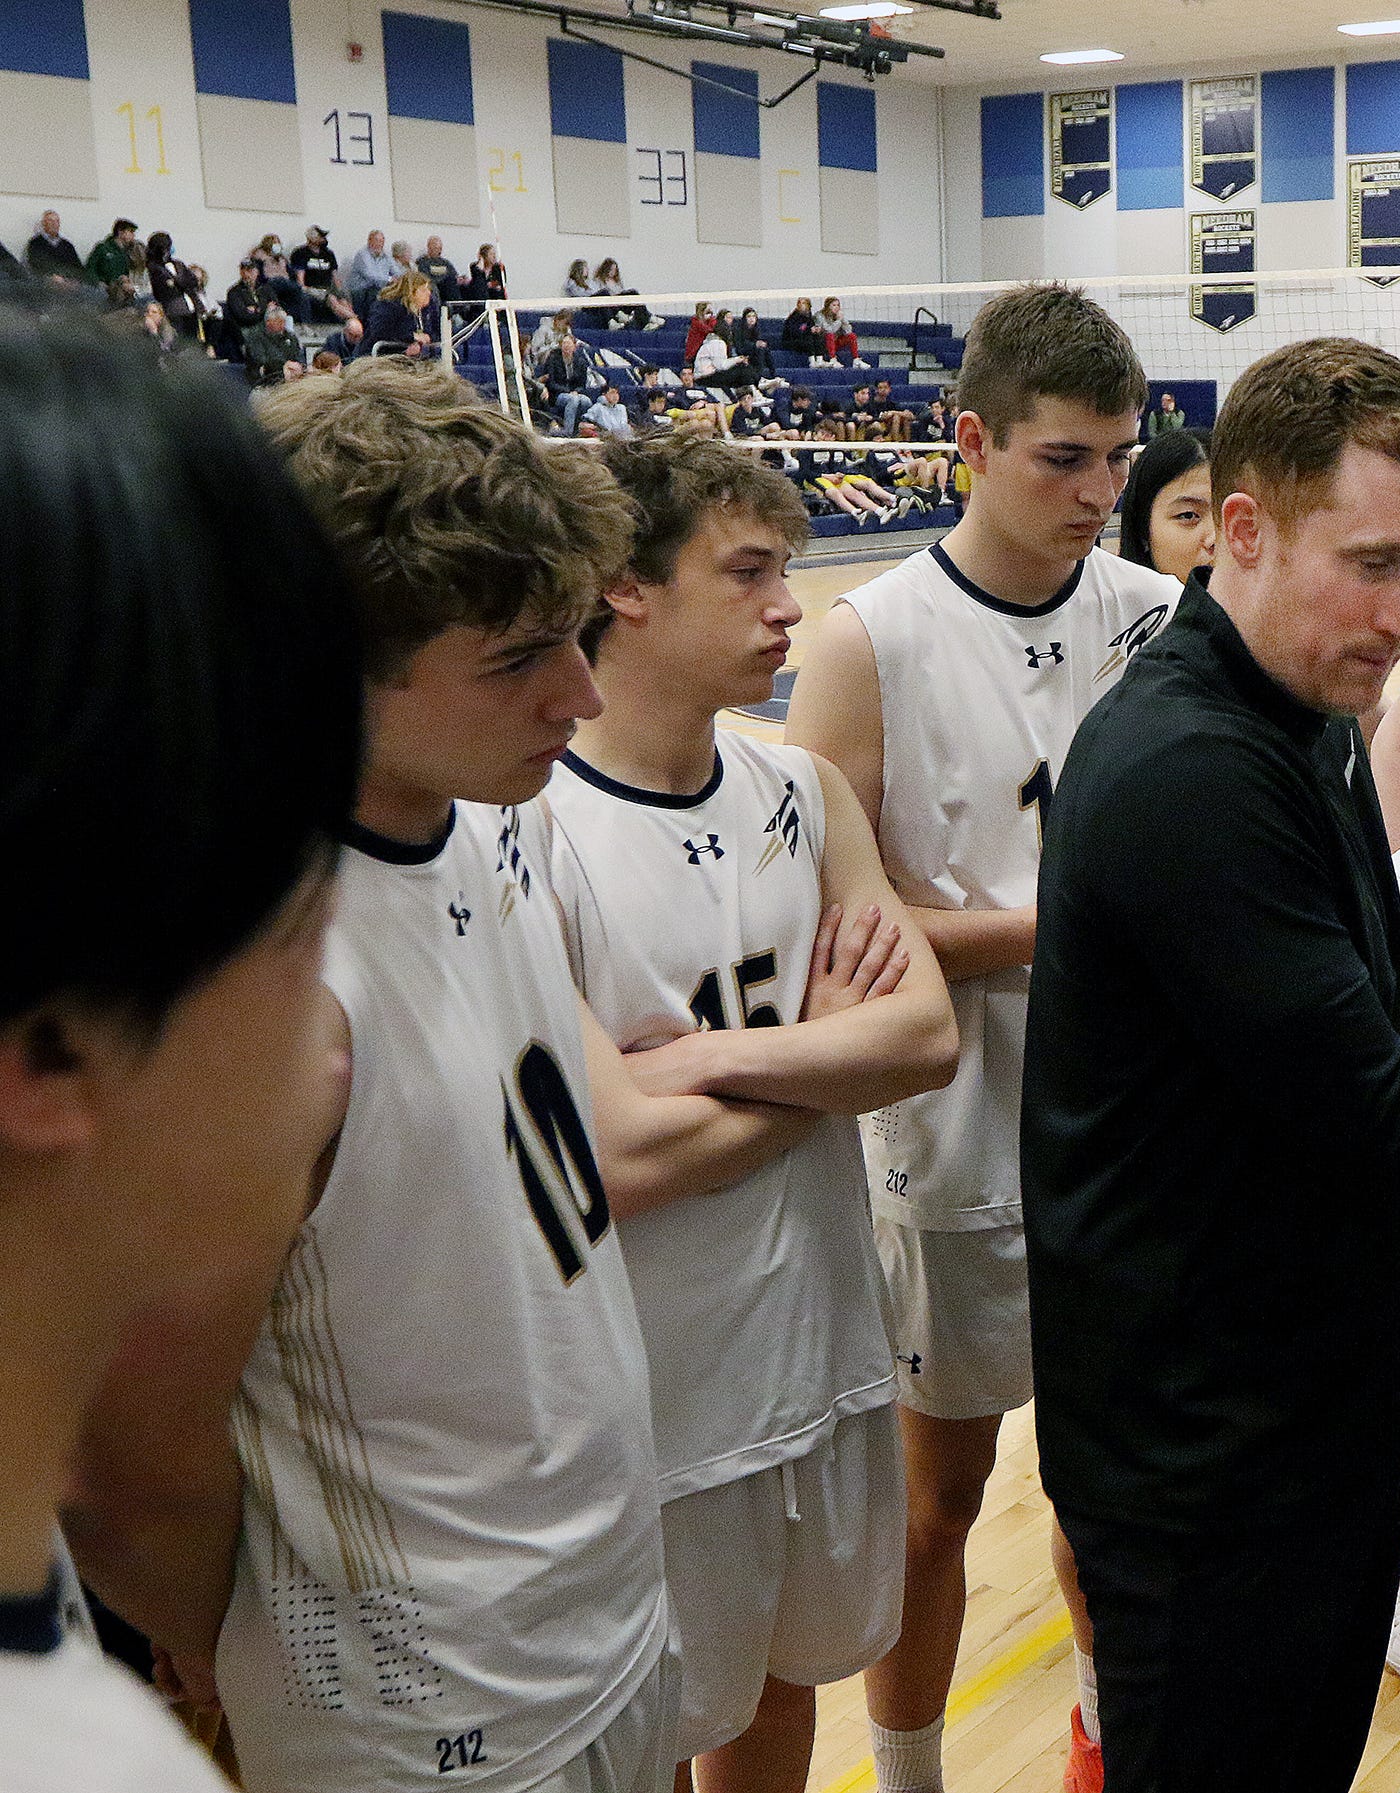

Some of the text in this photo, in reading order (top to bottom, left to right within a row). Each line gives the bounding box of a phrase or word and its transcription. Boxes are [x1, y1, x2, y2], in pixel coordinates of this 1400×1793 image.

[116, 101, 171, 175] 11
[323, 108, 375, 165] 13
[487, 147, 528, 193] 21
[636, 147, 688, 206] 33
[499, 1037, 612, 1289] 10
[886, 1168, 908, 1197] 212
[436, 1729, 488, 1774] 212
